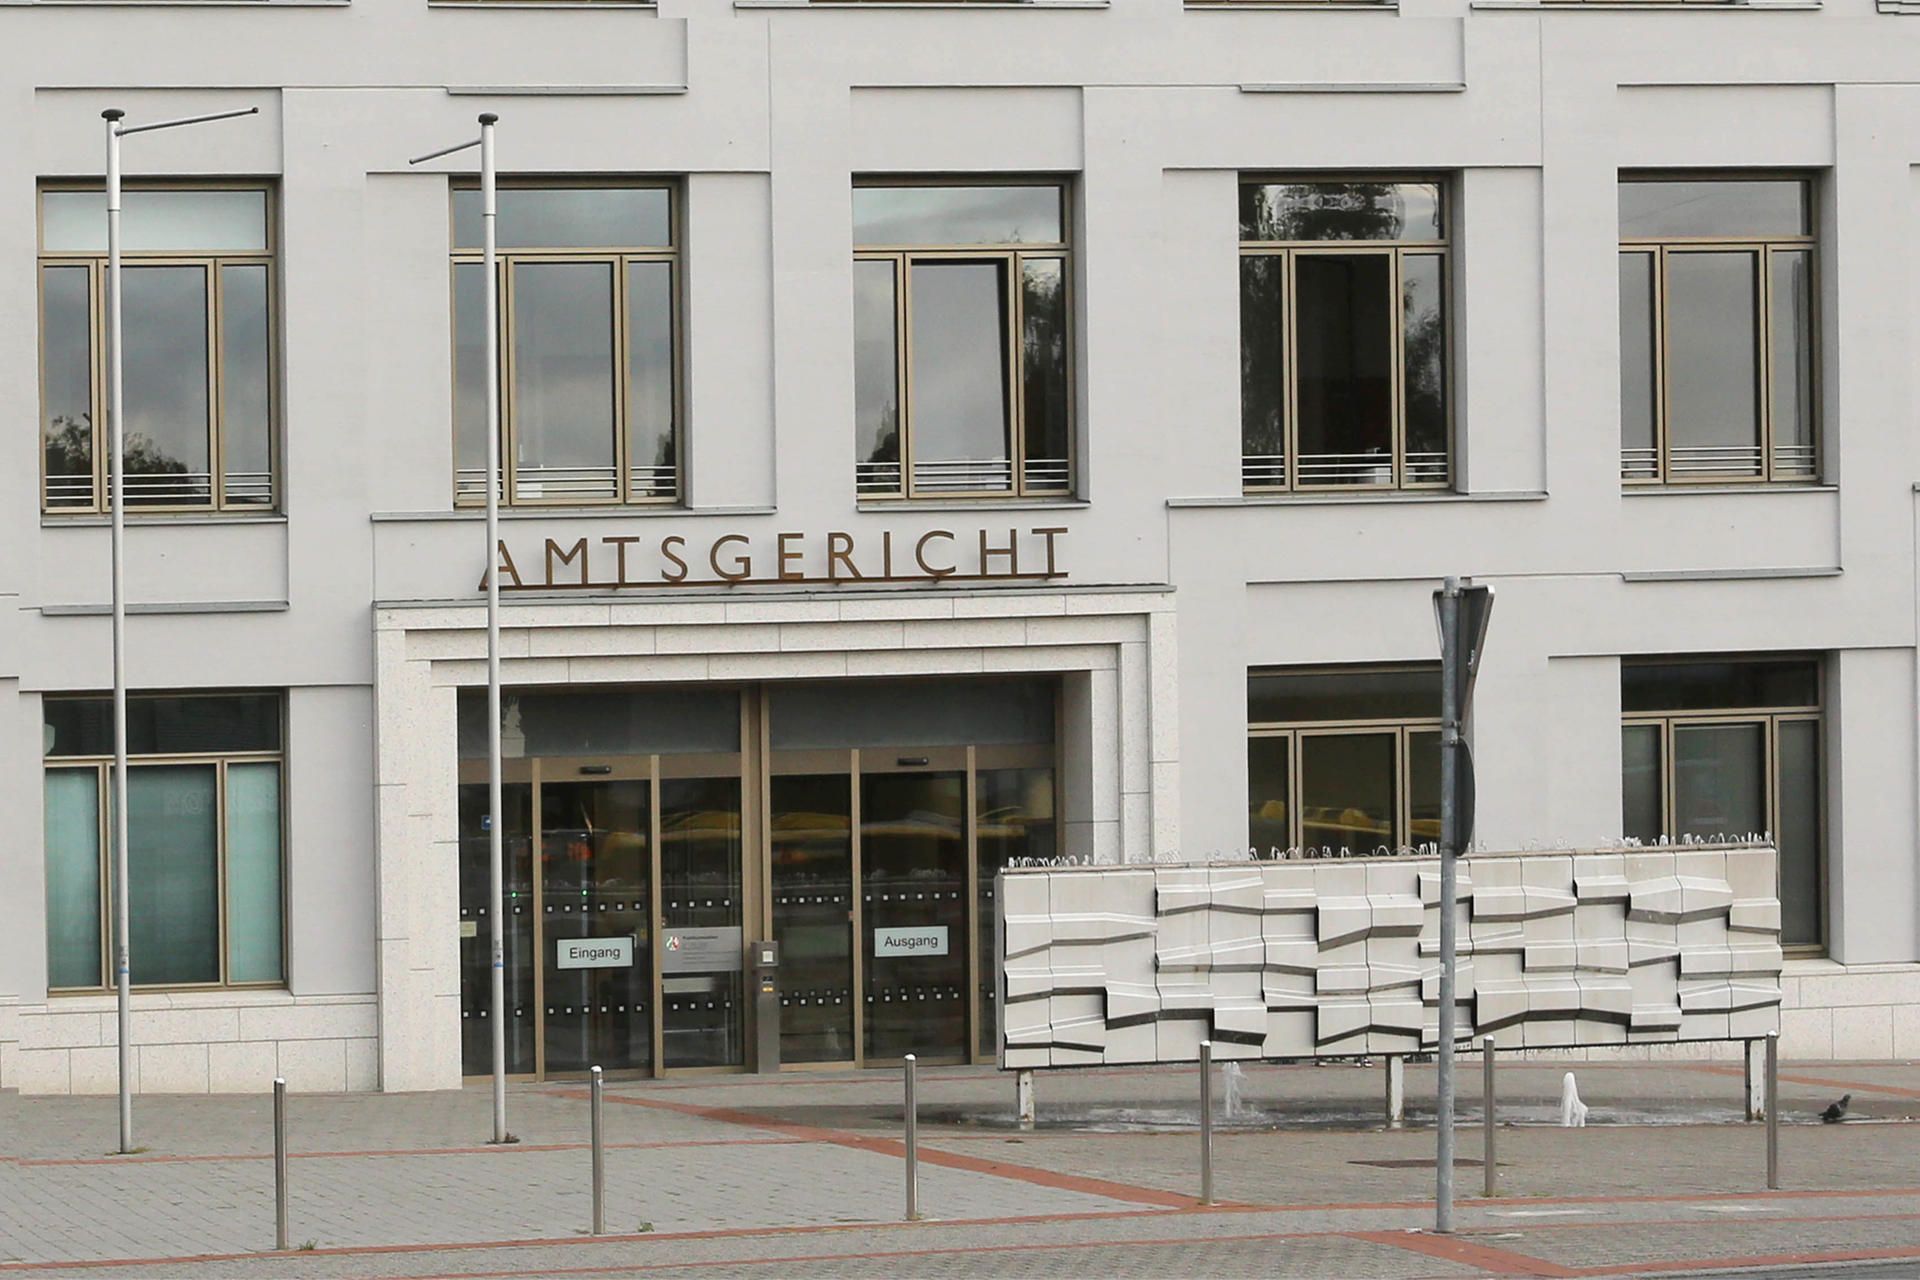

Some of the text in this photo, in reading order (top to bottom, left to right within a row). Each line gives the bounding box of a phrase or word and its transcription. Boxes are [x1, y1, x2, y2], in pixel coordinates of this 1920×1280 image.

[478, 527, 1068, 588] AMTSGERICHT
[884, 935, 938, 950] Ausgang
[569, 946, 621, 960] Eingang
